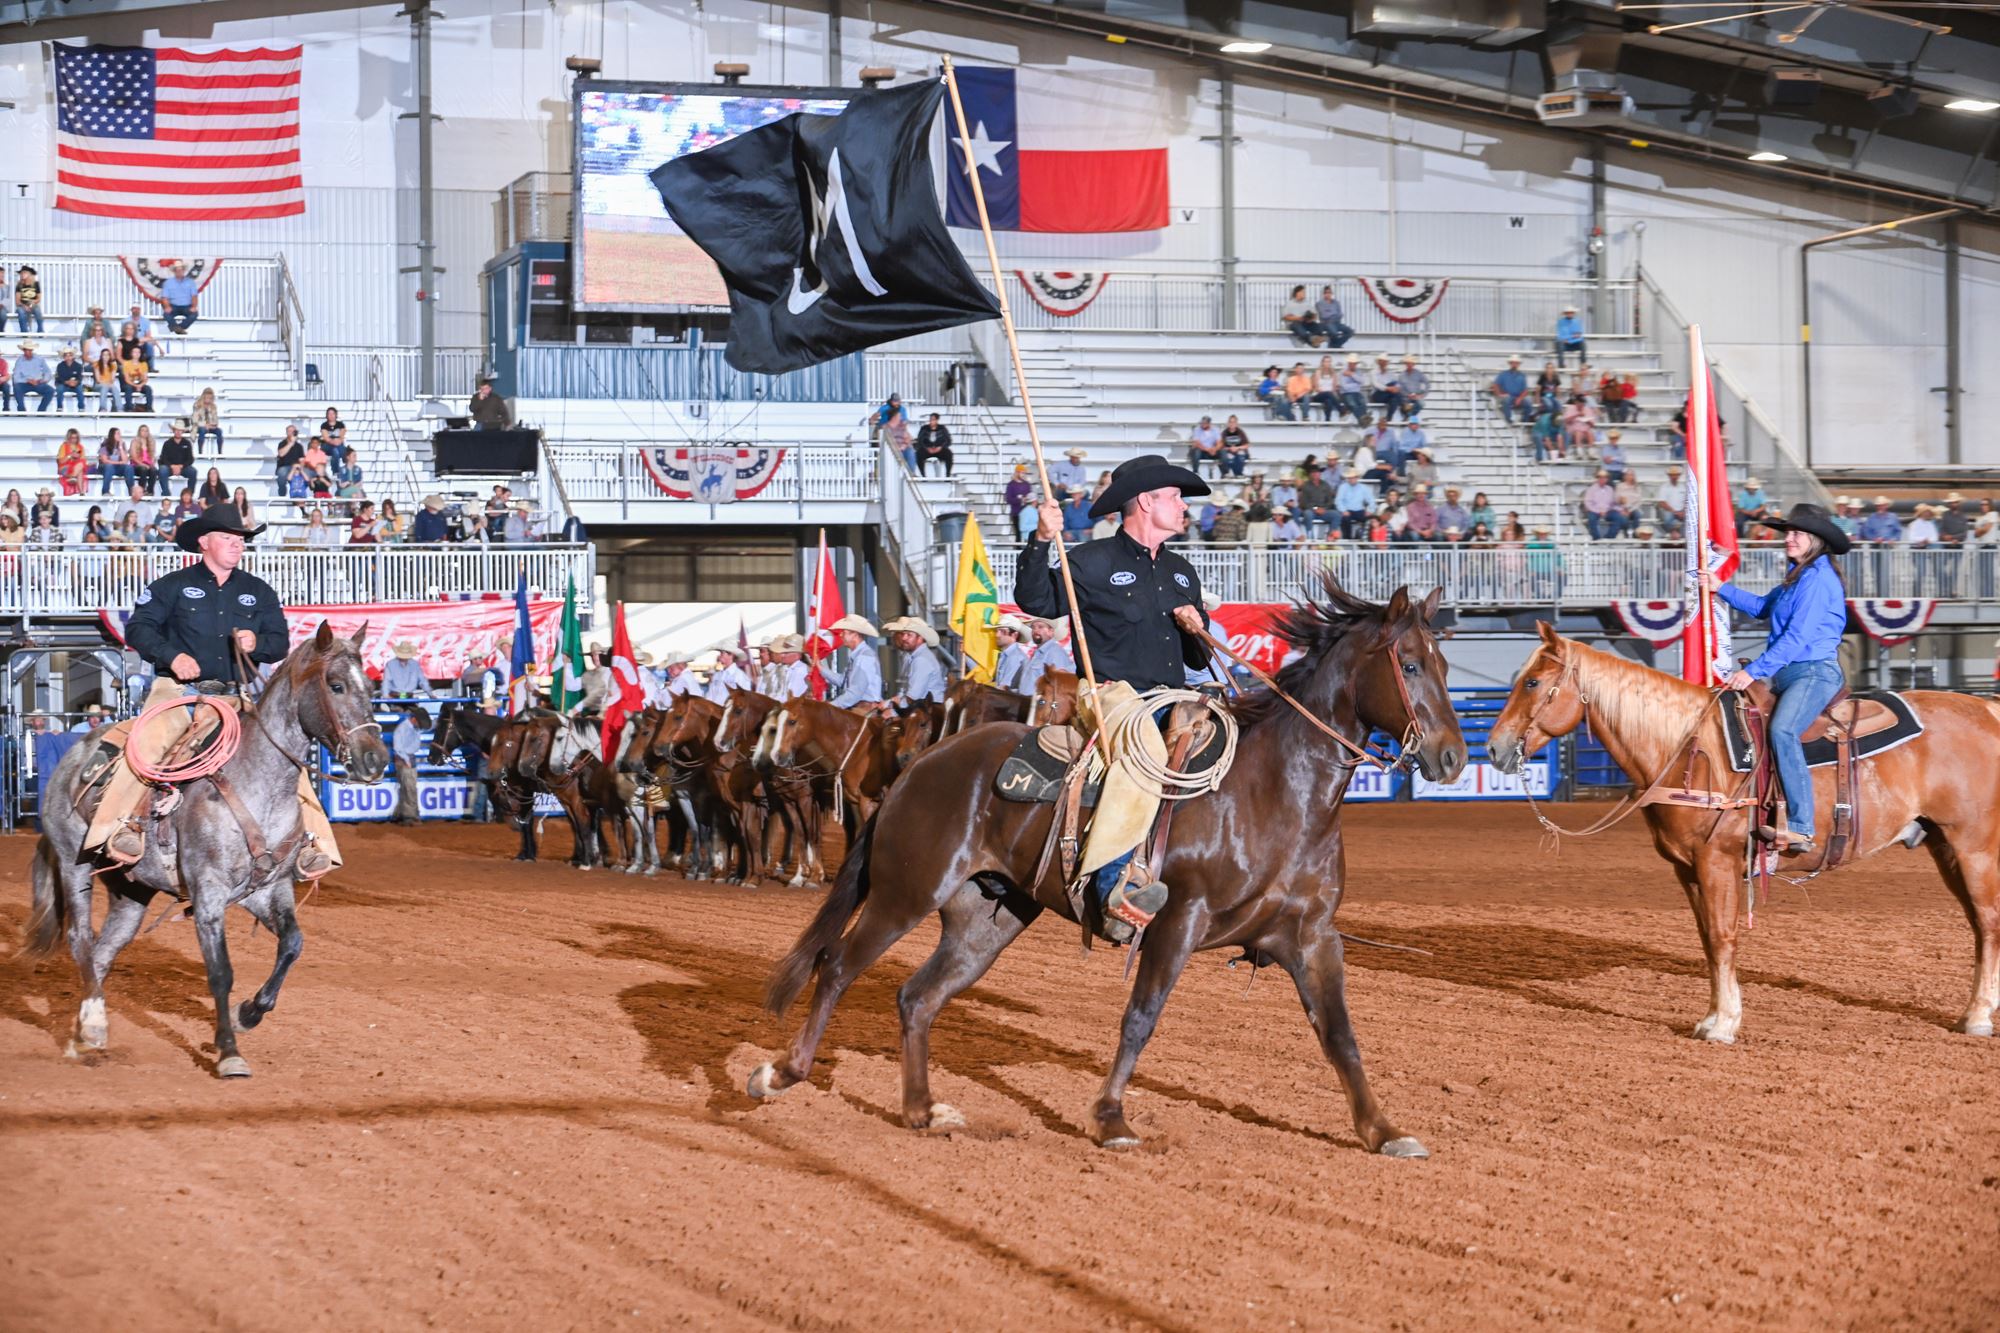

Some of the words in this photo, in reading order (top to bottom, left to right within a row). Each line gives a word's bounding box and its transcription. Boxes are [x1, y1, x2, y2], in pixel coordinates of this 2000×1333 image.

[17, 184, 29, 197] T
[1181, 209, 1194, 221] V
[1509, 216, 1524, 228] W
[690, 404, 703, 418] U
[338, 788, 393, 811] BUD
[420, 786, 472, 810] GHT
